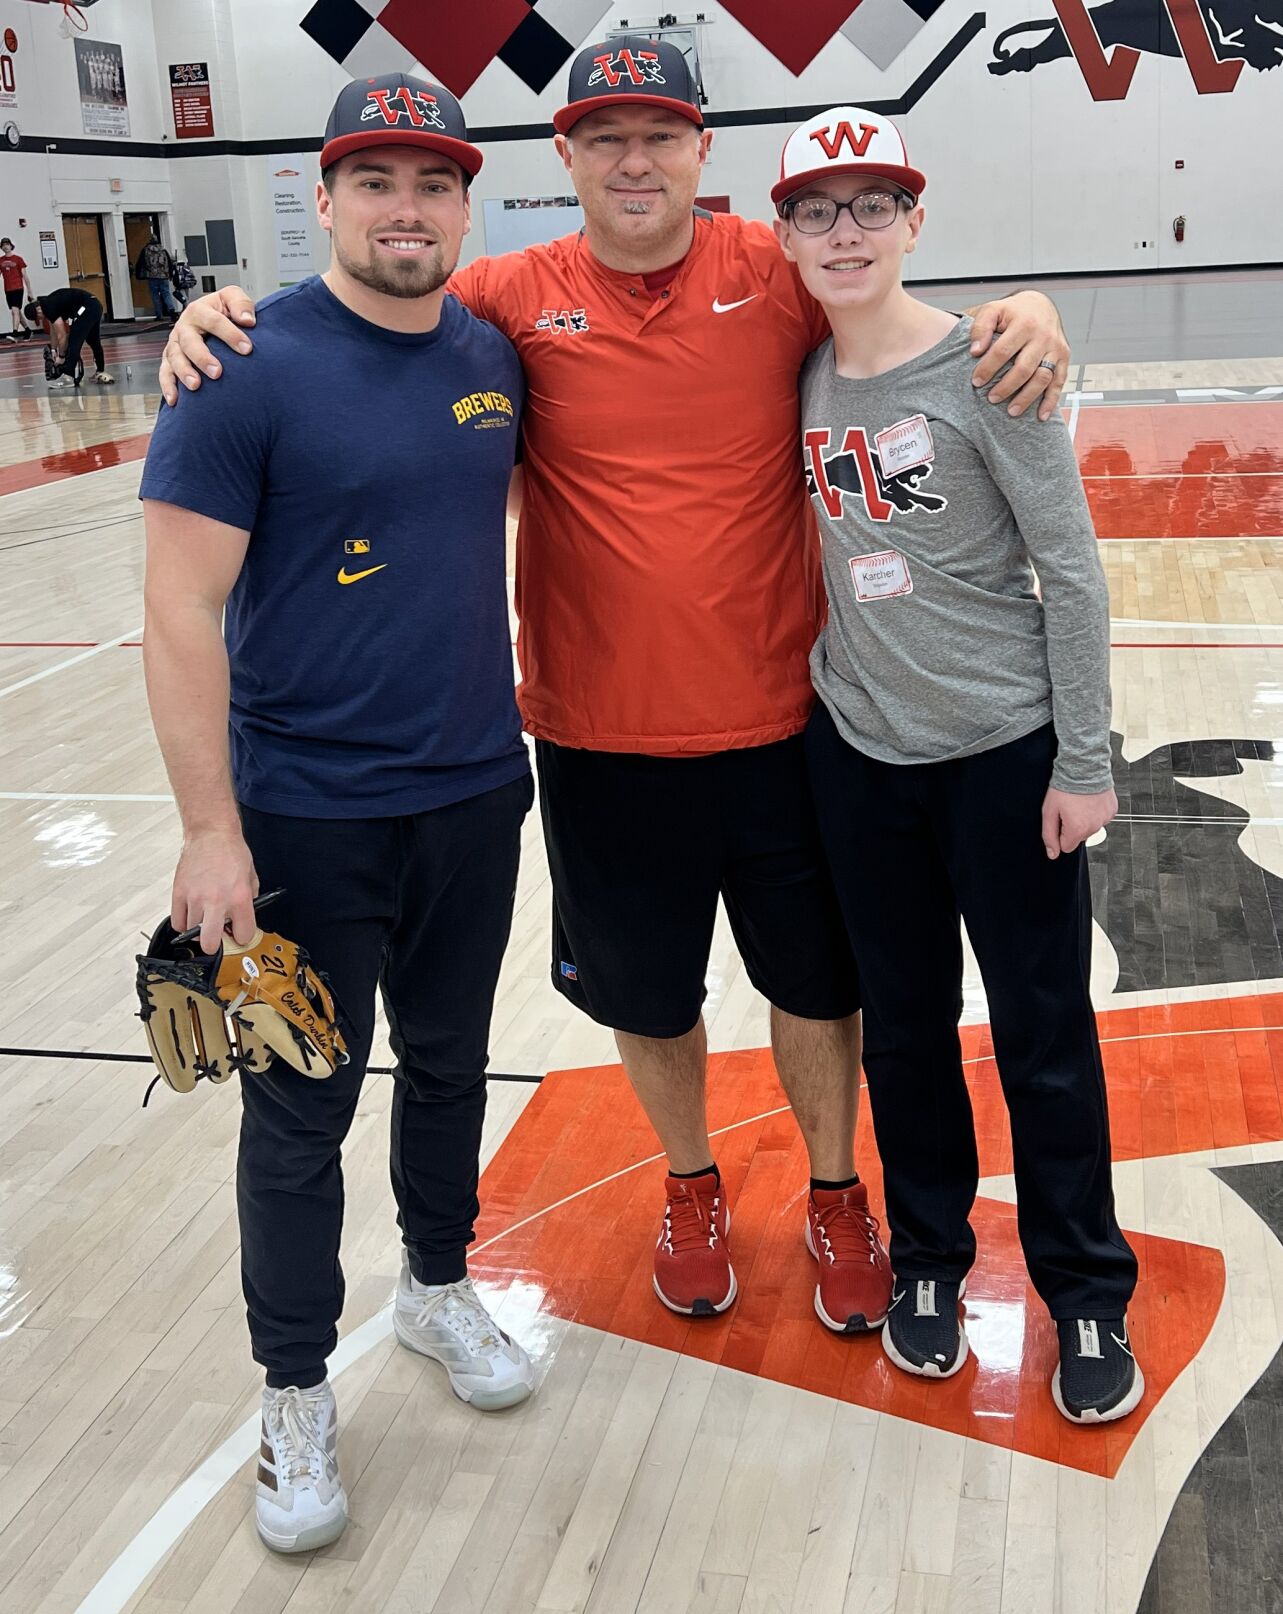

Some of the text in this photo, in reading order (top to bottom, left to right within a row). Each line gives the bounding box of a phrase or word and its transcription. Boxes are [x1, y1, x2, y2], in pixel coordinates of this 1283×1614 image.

[809, 120, 879, 160] W
[452, 391, 514, 425] BREWERS
[889, 440, 917, 458] Brycen
[863, 570, 895, 582] Karcher
[261, 954, 288, 977] 21
[281, 991, 329, 1050] Caleb Durbin
